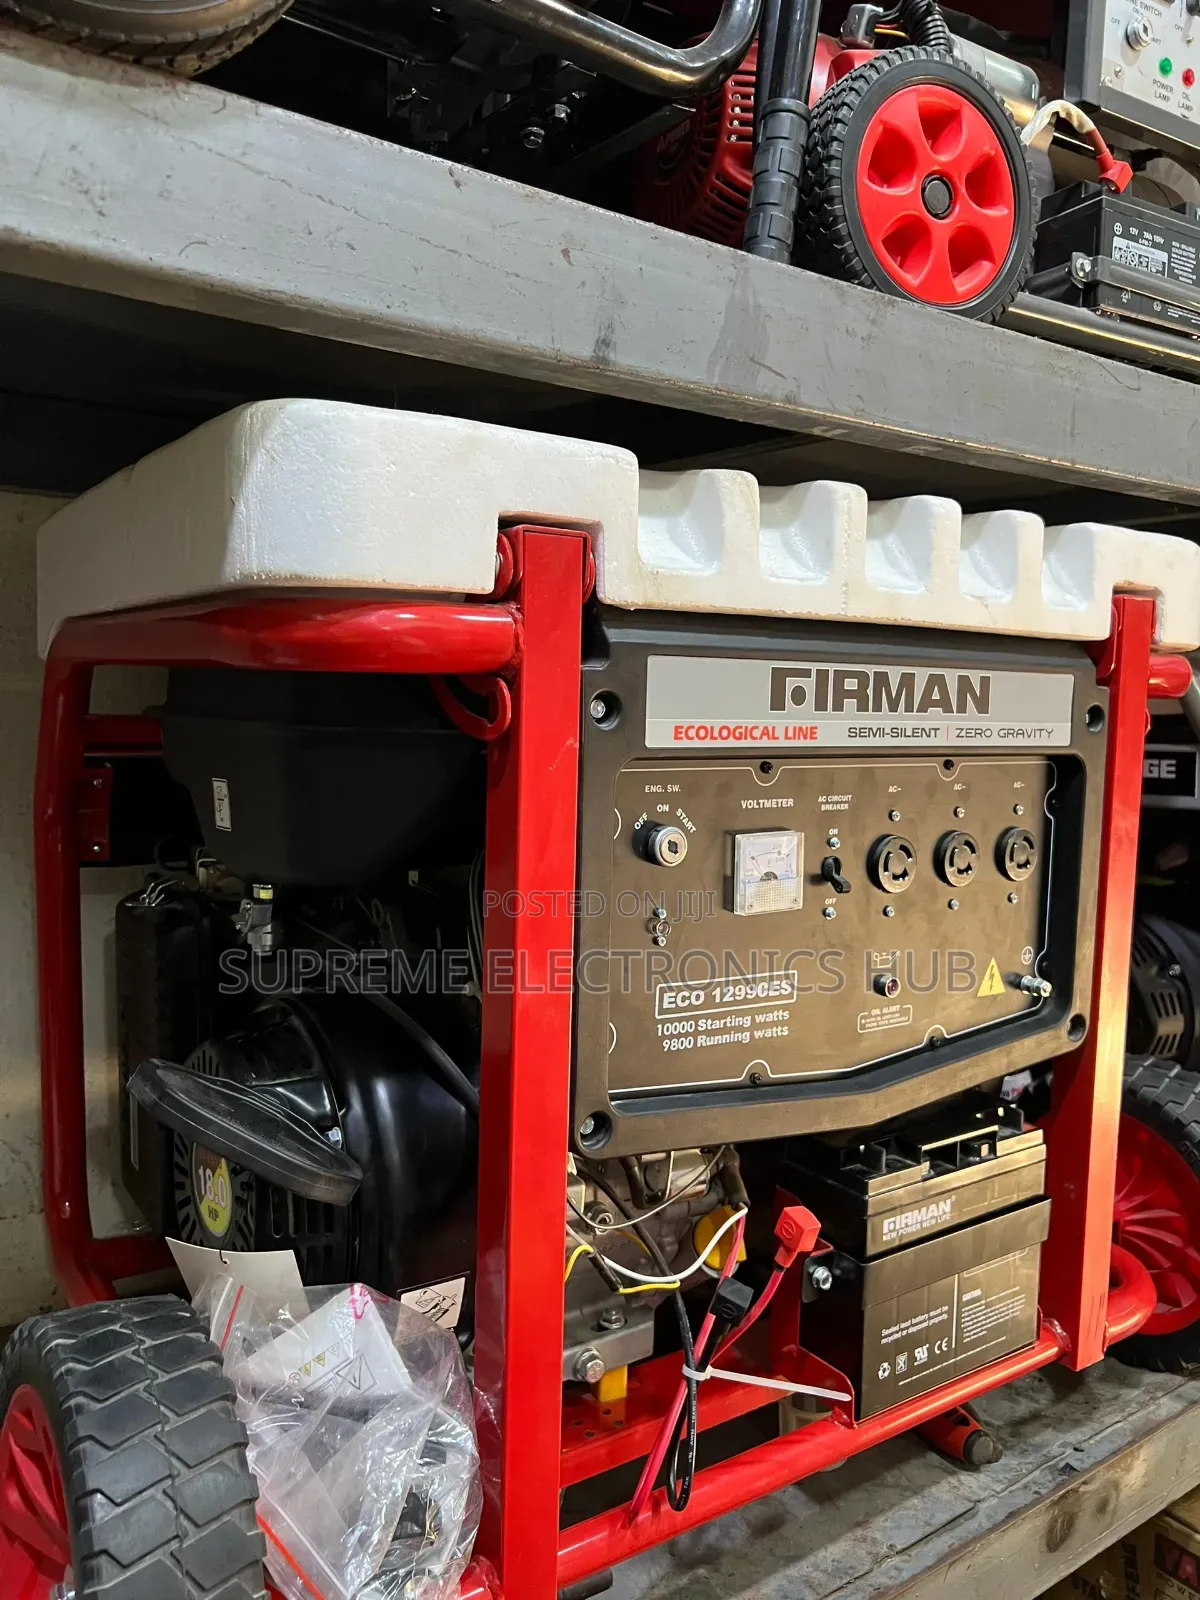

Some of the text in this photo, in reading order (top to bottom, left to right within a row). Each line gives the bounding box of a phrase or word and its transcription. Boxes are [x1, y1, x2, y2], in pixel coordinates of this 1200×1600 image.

[1140, 1, 1162, 17] SWITCH
[1152, 79, 1174, 94] POWER
[1155, 91, 1171, 103] LAMP
[1178, 101, 1194, 112] LAMP
[769, 666, 992, 717] FIRMAN
[673, 725, 818, 741] ECOLOGICAL LINE
[847, 727, 1054, 739] SEMI-SILENT ZERO GRAVITY
[644, 784, 682, 793] ENG. SW.
[656, 804, 669, 812] ON
[741, 798, 794, 809] VOLTMETER
[821, 803, 849, 811] BREAKER
[634, 812, 649, 830] OFF
[676, 808, 697, 834] START
[825, 897, 837, 905] OFF
[662, 979, 793, 1009] ECO 12990ES
[882, 1004, 901, 1014] ALERT
[656, 1009, 790, 1037] 10000 Starting watts
[662, 1025, 789, 1052] 9800 Running watts
[199, 1165, 227, 1209] 18.0
[208, 1205, 219, 1222] HP
[882, 1199, 952, 1234] FIRMAN
[882, 1212, 951, 1241] NEW POWER NEW LIFE
[881, 1323, 900, 1337] Sealed
